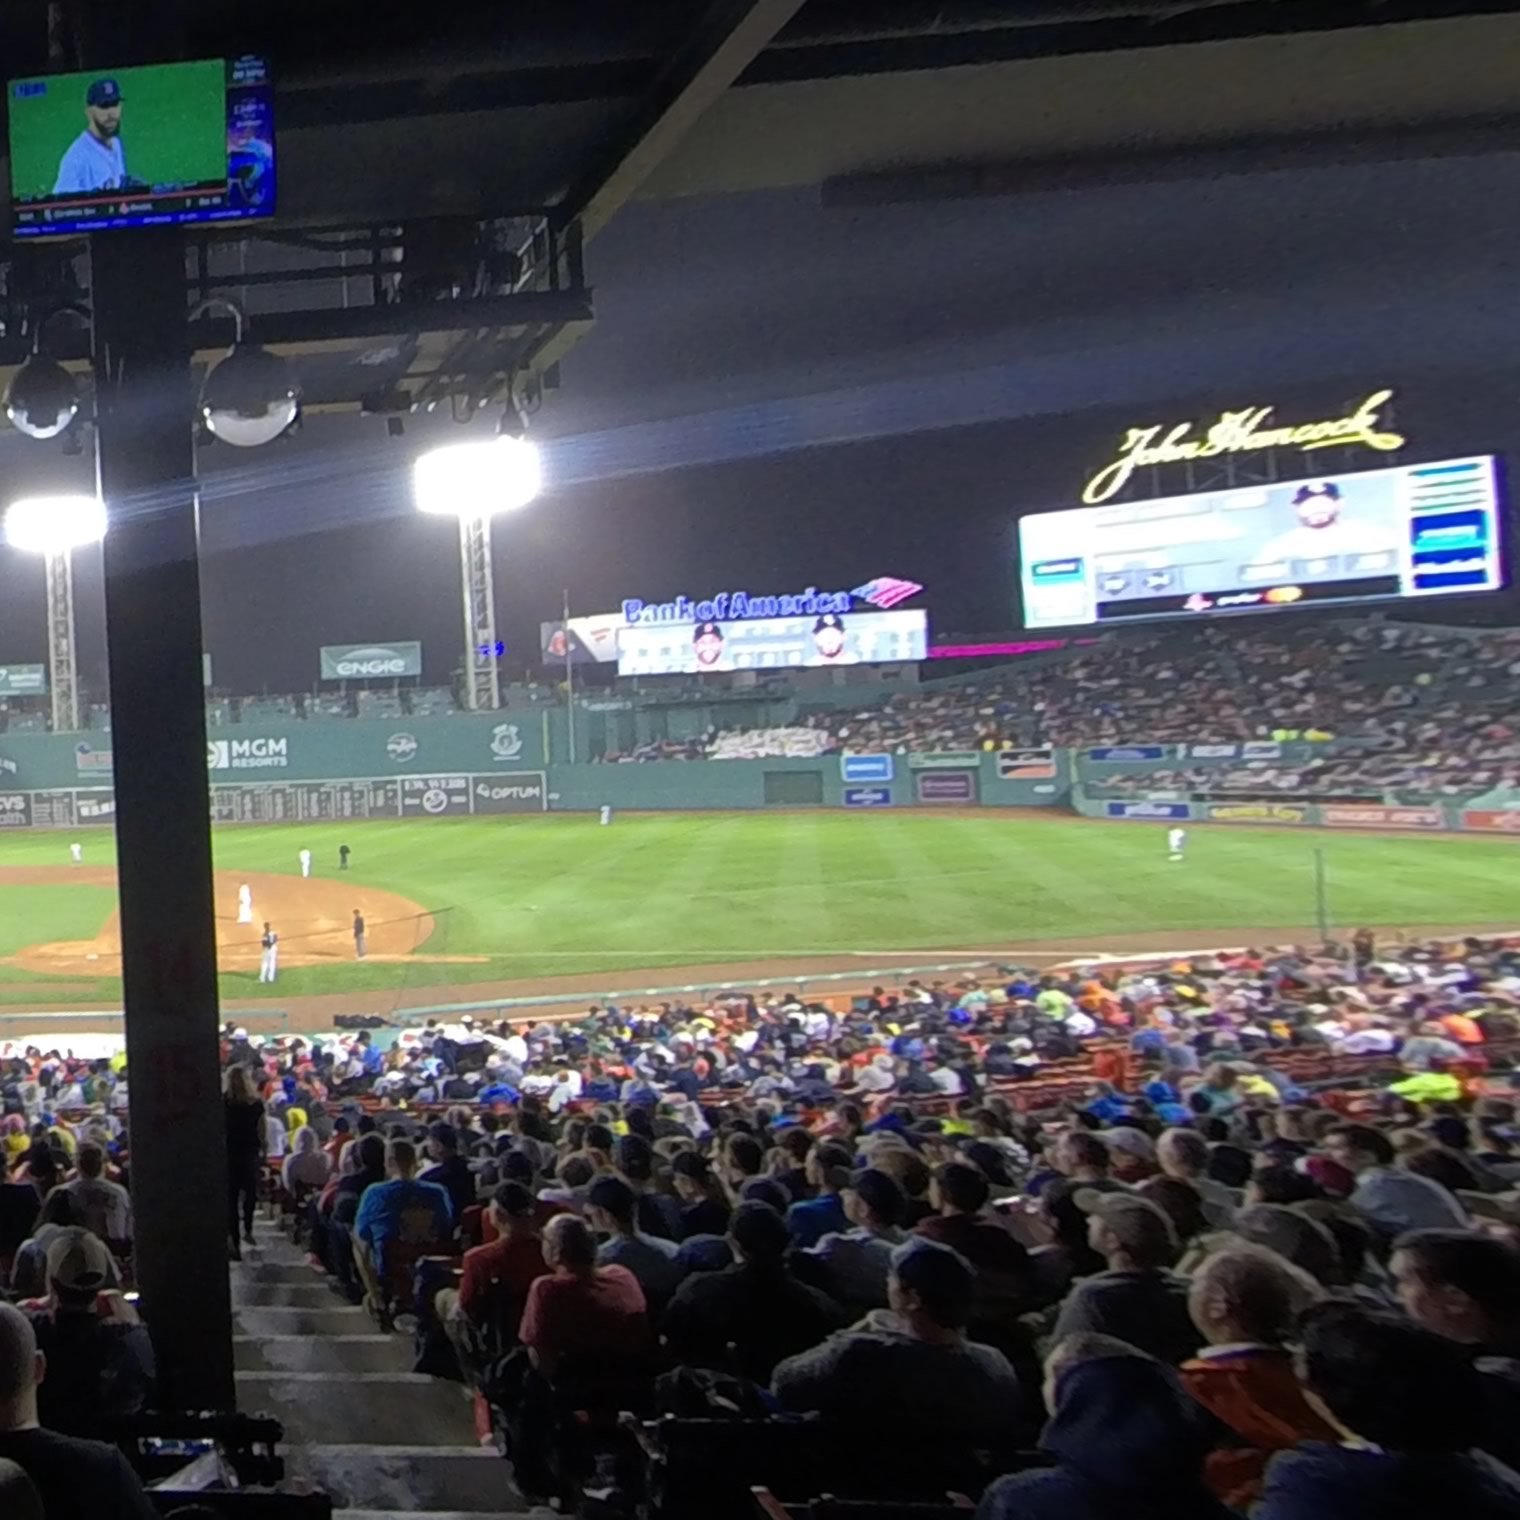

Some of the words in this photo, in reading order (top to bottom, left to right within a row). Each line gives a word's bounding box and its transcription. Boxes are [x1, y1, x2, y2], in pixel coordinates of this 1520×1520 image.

[1082, 422, 1202, 504] John
[1204, 390, 1405, 453] Hancock
[622, 596, 696, 623] Bank
[696, 591, 730, 620] of
[730, 586, 853, 619] America
[231, 738, 287, 757] MGM
[231, 756, 288, 768] RESORTS
[491, 786, 541, 799] OPTUM
